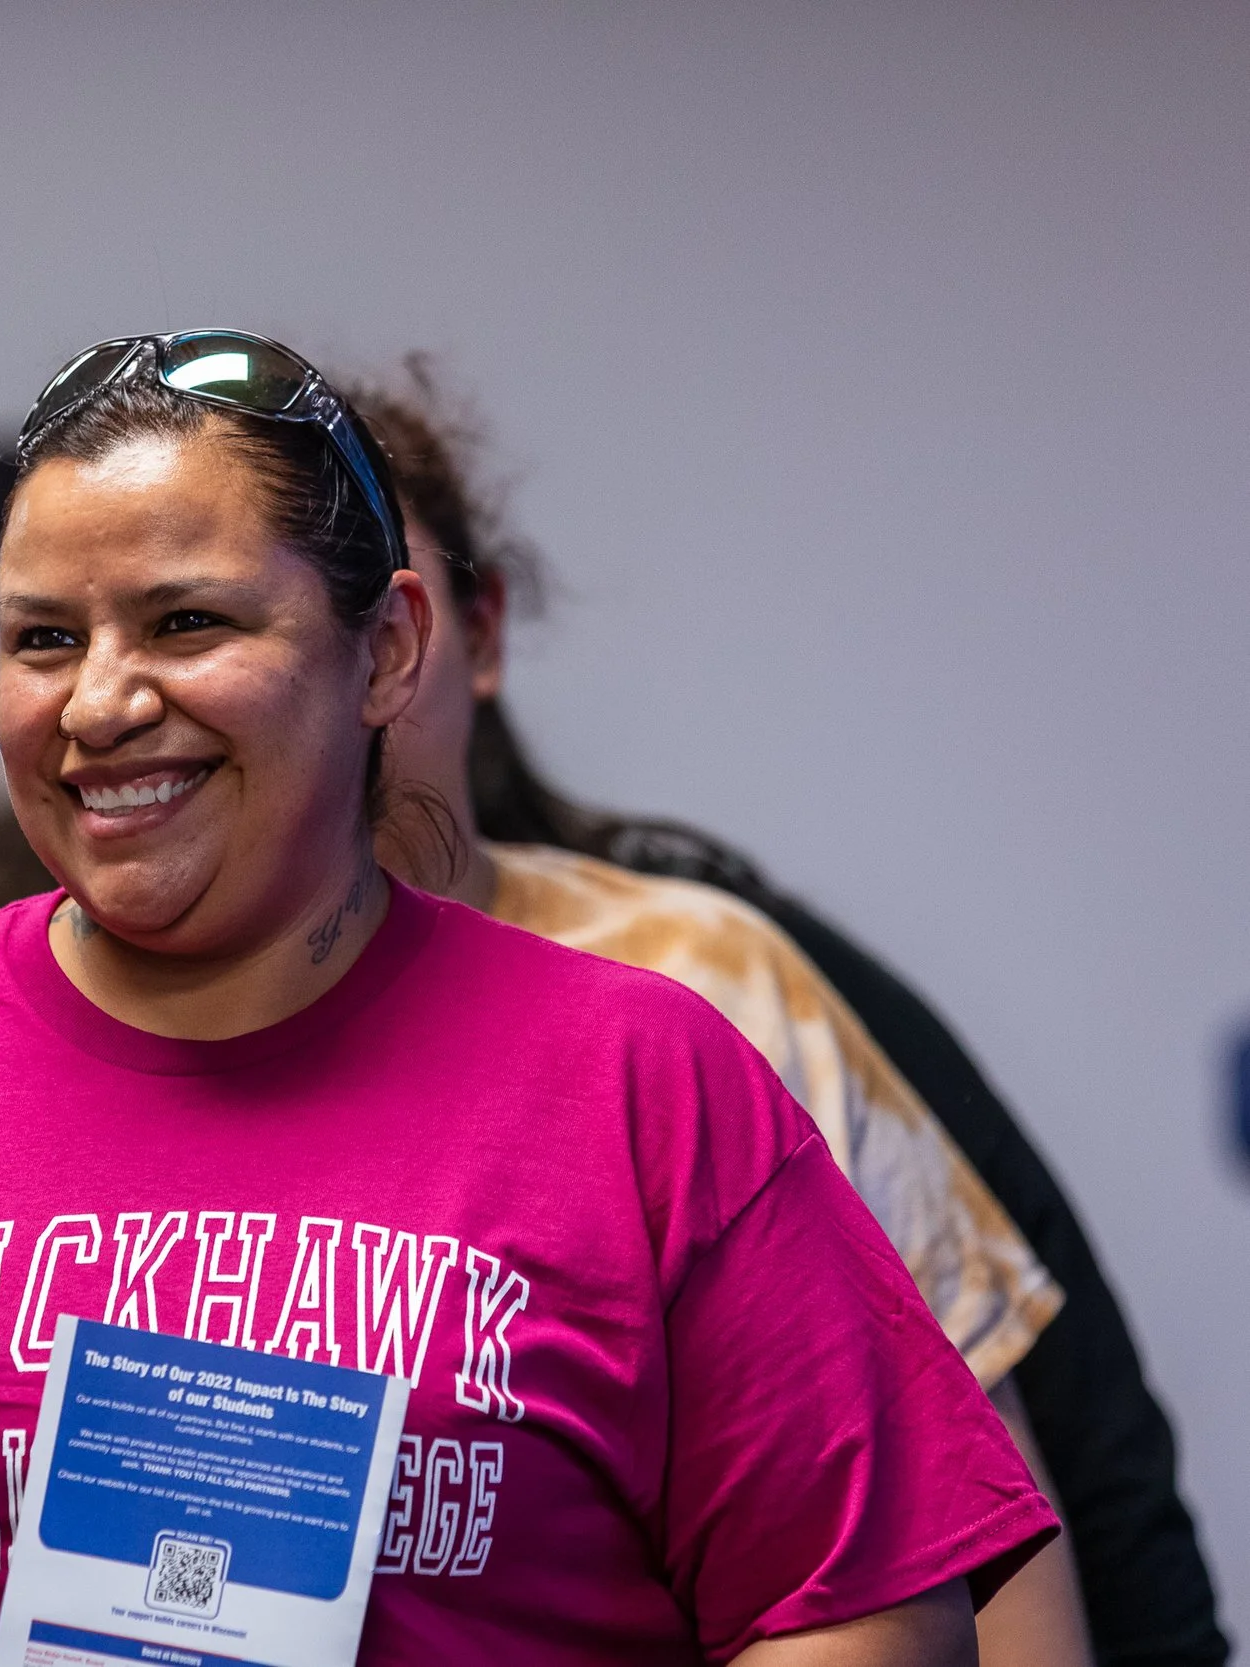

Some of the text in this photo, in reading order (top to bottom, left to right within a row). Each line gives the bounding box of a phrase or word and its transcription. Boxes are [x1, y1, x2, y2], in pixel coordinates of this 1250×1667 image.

[84, 1349, 369, 1419] The Story of Our 2022 Impact Is The Story
[168, 1386, 275, 1419] of our Students
[143, 1463, 173, 1475] THANK
[174, 1468, 192, 1479] YOU
[193, 1472, 206, 1482] TO
[207, 1475, 223, 1485] ALL
[224, 1478, 244, 1489] OUR
